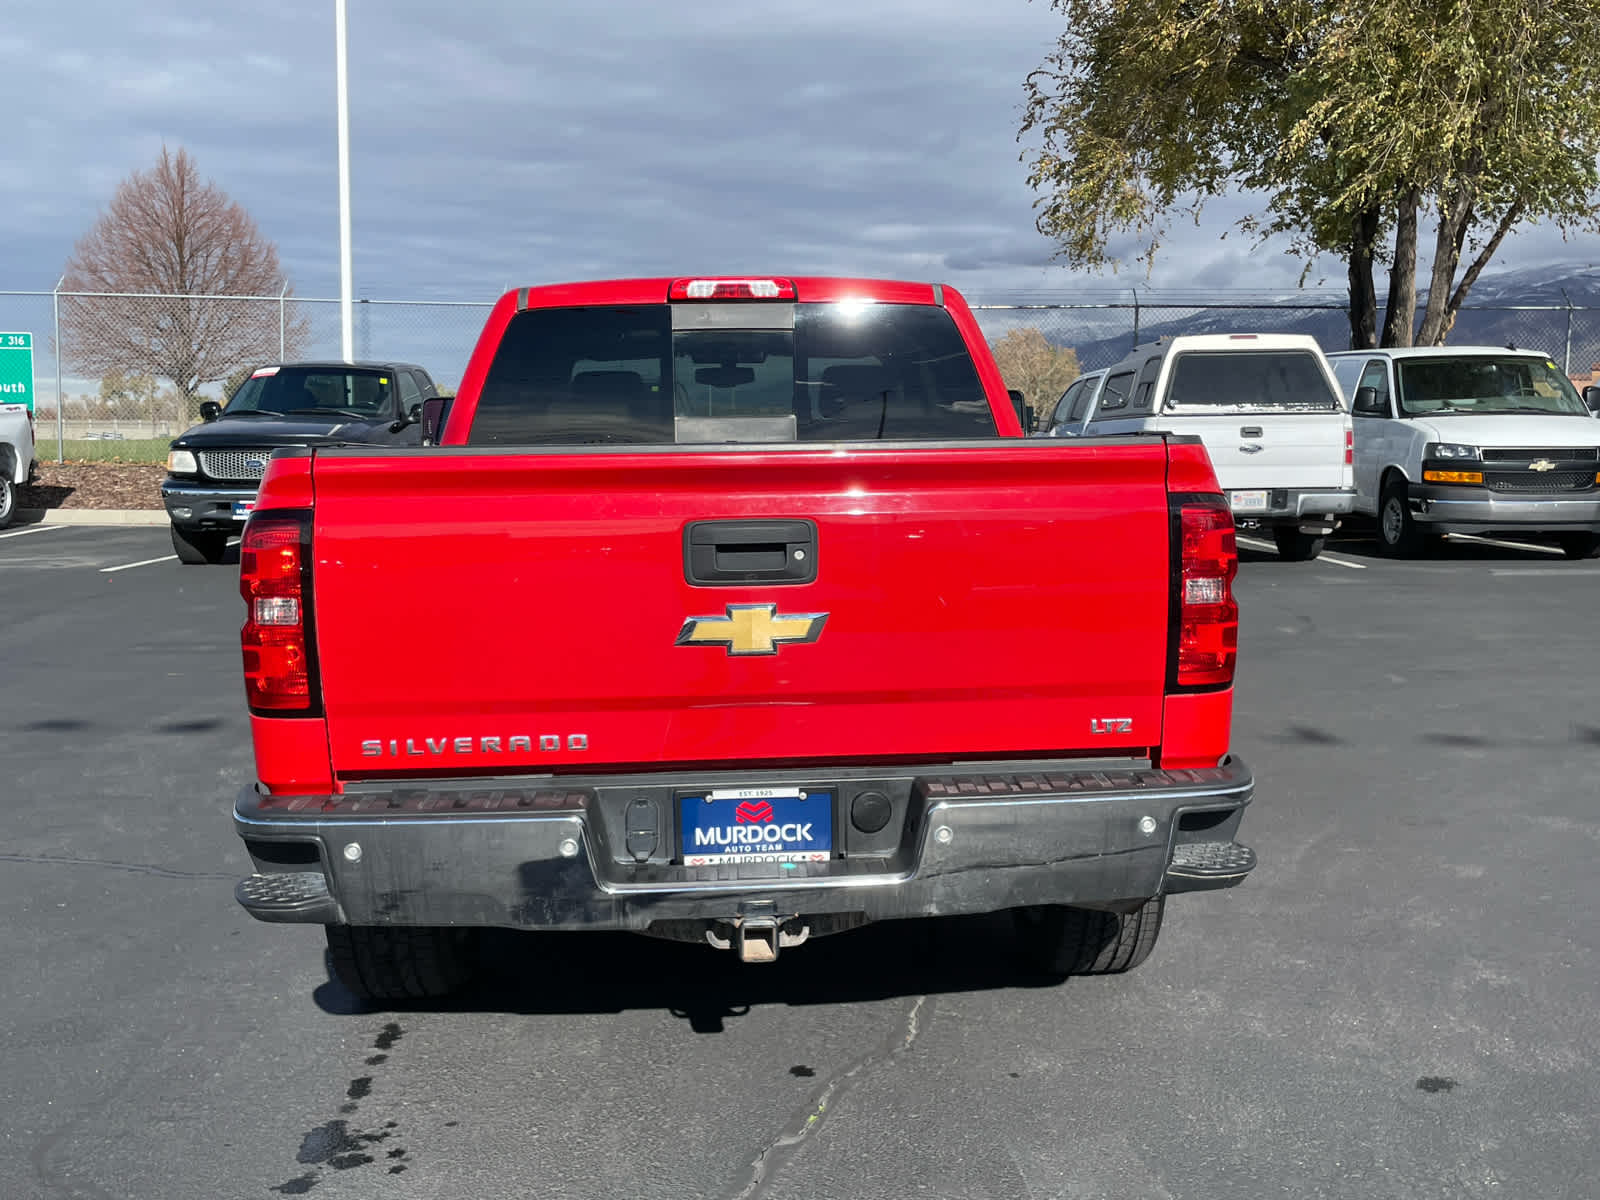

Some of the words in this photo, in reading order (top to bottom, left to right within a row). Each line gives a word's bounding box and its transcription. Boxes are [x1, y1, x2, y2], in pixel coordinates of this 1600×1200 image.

[8, 336, 25, 346] 316
[1091, 718, 1132, 734] LTZ
[361, 733, 588, 757] SILVERADO
[695, 823, 814, 846] MURDOCK
[724, 845, 752, 853] AUTO
[756, 843, 783, 852] TEAM
